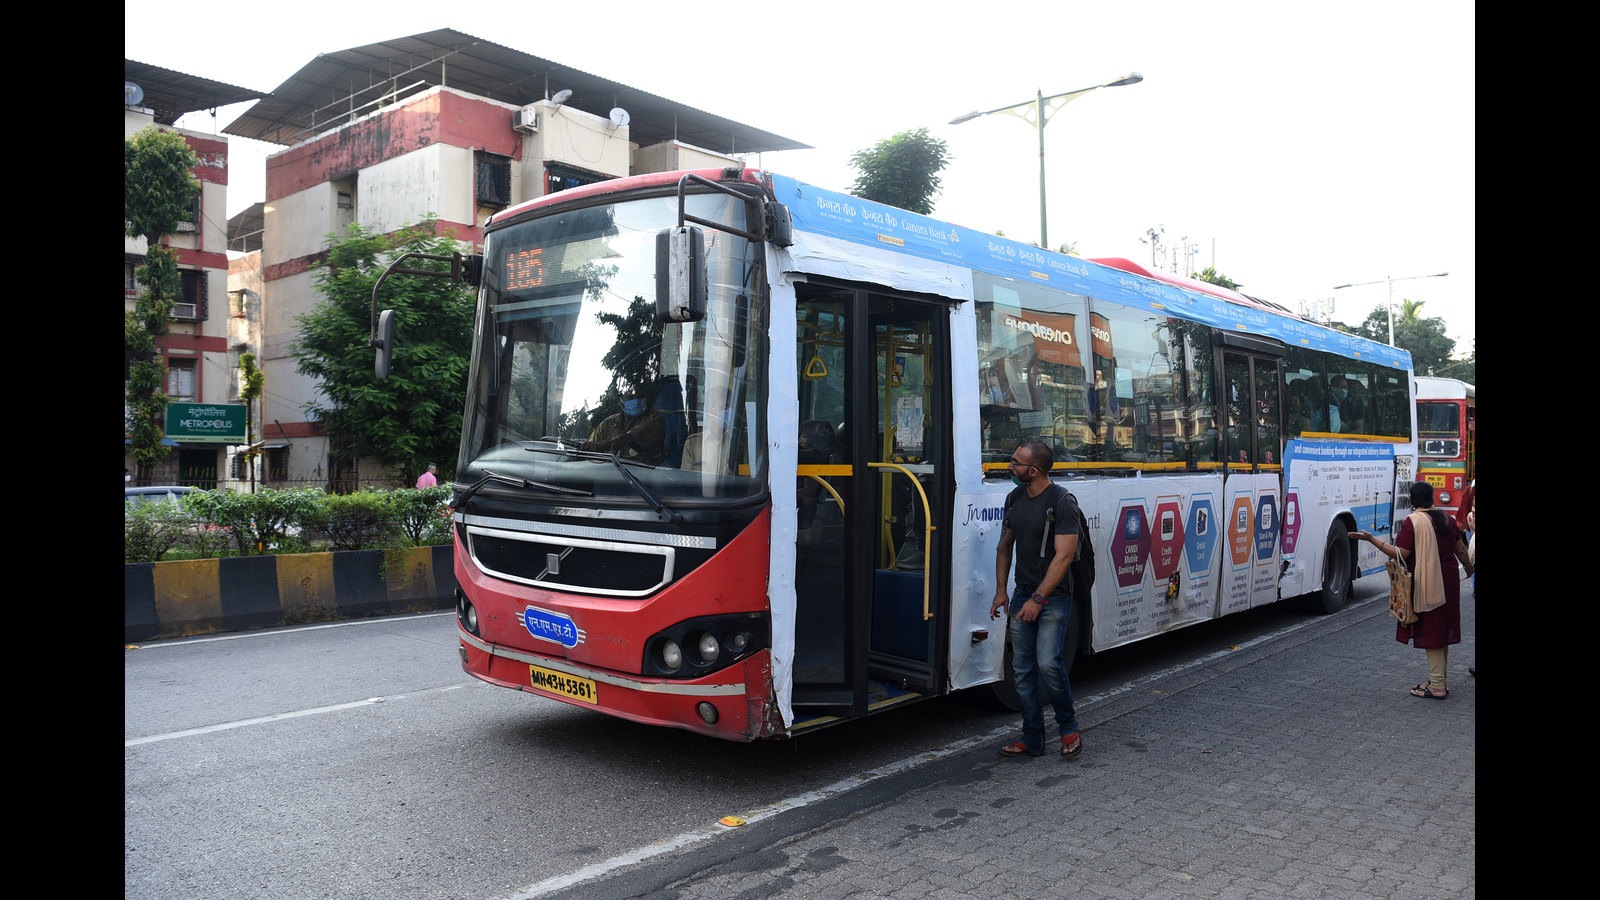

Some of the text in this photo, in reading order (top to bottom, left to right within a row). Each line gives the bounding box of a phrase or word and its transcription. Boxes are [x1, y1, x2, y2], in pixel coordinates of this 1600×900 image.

[901, 220, 928, 235] Canara
[929, 226, 947, 240] Bank
[506, 248, 543, 290] 105
[180, 419, 233, 429] METROPOLIS
[1125, 543, 1138, 554] CANDI
[1161, 546, 1173, 556] Credit
[1124, 554, 1139, 565] Mobile
[1162, 556, 1171, 566] Card
[1118, 563, 1143, 575] Banking App
